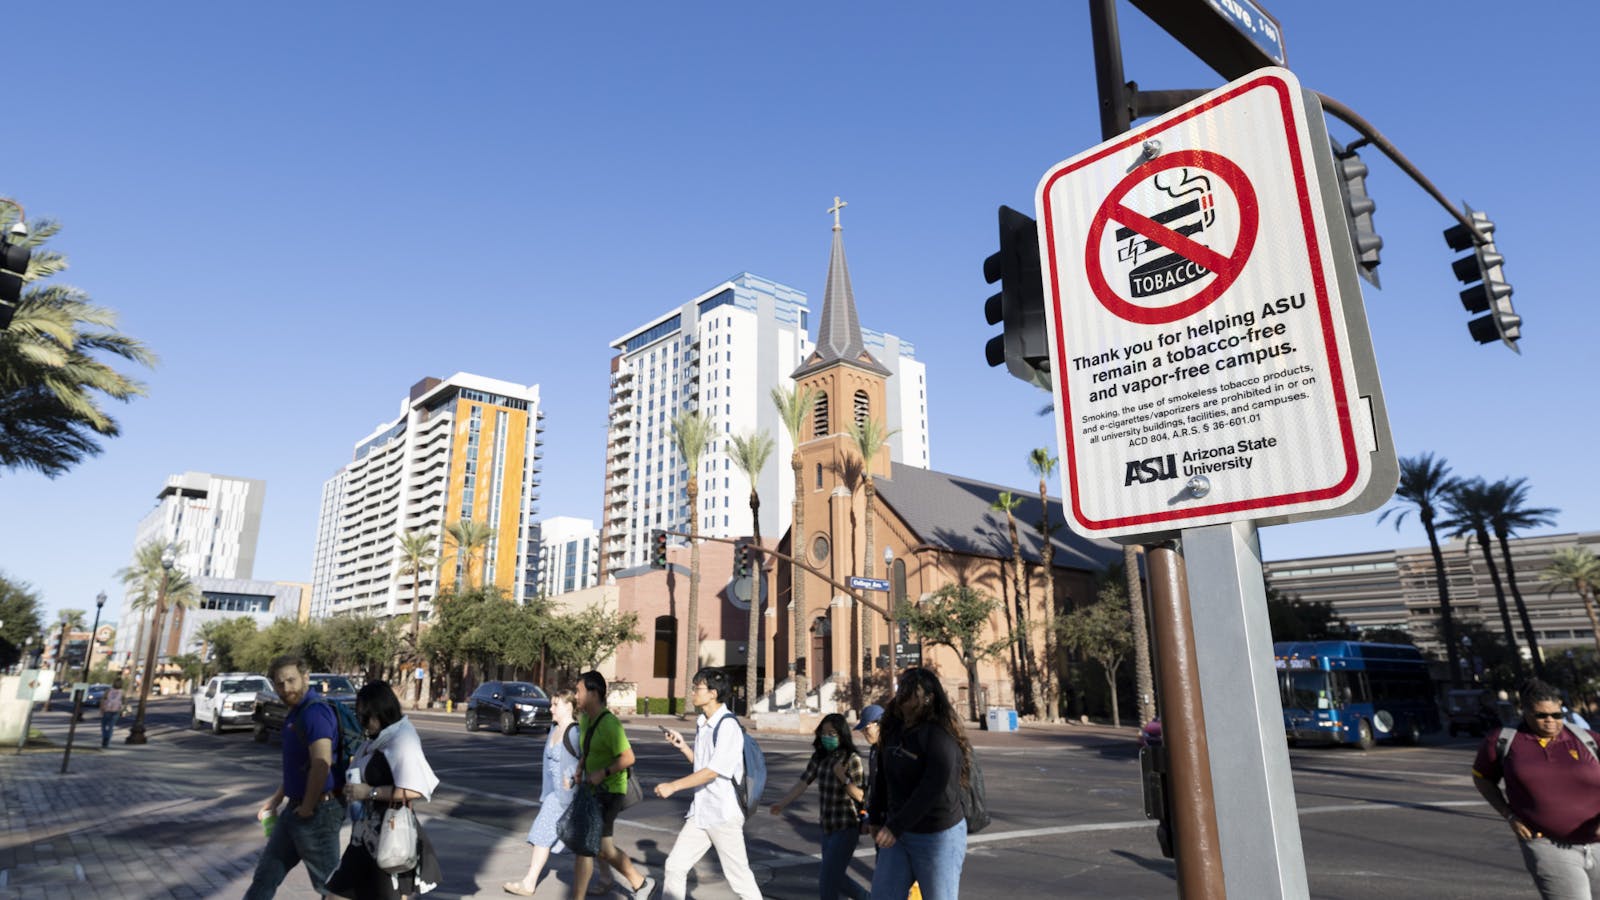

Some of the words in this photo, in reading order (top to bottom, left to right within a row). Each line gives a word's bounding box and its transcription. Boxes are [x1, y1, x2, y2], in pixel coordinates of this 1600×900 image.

[1133, 262, 1206, 293] TOBACCO
[1073, 348, 1120, 371] Thank
[1123, 341, 1153, 362] you
[1158, 328, 1181, 347] for
[1187, 310, 1255, 340] helping
[1261, 293, 1306, 319] ASU
[1092, 360, 1147, 383] remain
[1152, 356, 1162, 368] a
[1167, 322, 1286, 364] tobacco-free
[1089, 384, 1118, 402] and
[1122, 363, 1210, 393] vapor-free
[1216, 341, 1297, 371] campus.
[1122, 405, 1136, 414] the
[1138, 401, 1154, 411] use
[1157, 397, 1166, 406] of
[1168, 387, 1218, 403] smokeless
[1220, 377, 1260, 392] tobacco
[1263, 364, 1314, 383] products,
[1082, 424, 1098, 434] and
[1100, 402, 1201, 431] e-cigarettes/vaporizers
[1203, 398, 1218, 408] are
[1221, 385, 1272, 405] prohibited
[1275, 383, 1284, 392] in
[1288, 380, 1299, 389] or
[1302, 376, 1316, 386] on
[1090, 435, 1099, 444] all
[1101, 427, 1141, 442] university
[1143, 418, 1186, 432] buildings,
[1187, 408, 1229, 423] facilities,
[1231, 404, 1249, 414] and
[1252, 391, 1310, 407] campuses.
[1128, 436, 1148, 447] ACD
[1172, 426, 1201, 438] A.R.S.
[1213, 413, 1261, 431] 36-601.01
[1124, 454, 1179, 486] ASU
[1182, 444, 1235, 463] Arizona
[1237, 436, 1277, 453] State
[1183, 456, 1253, 477] University
